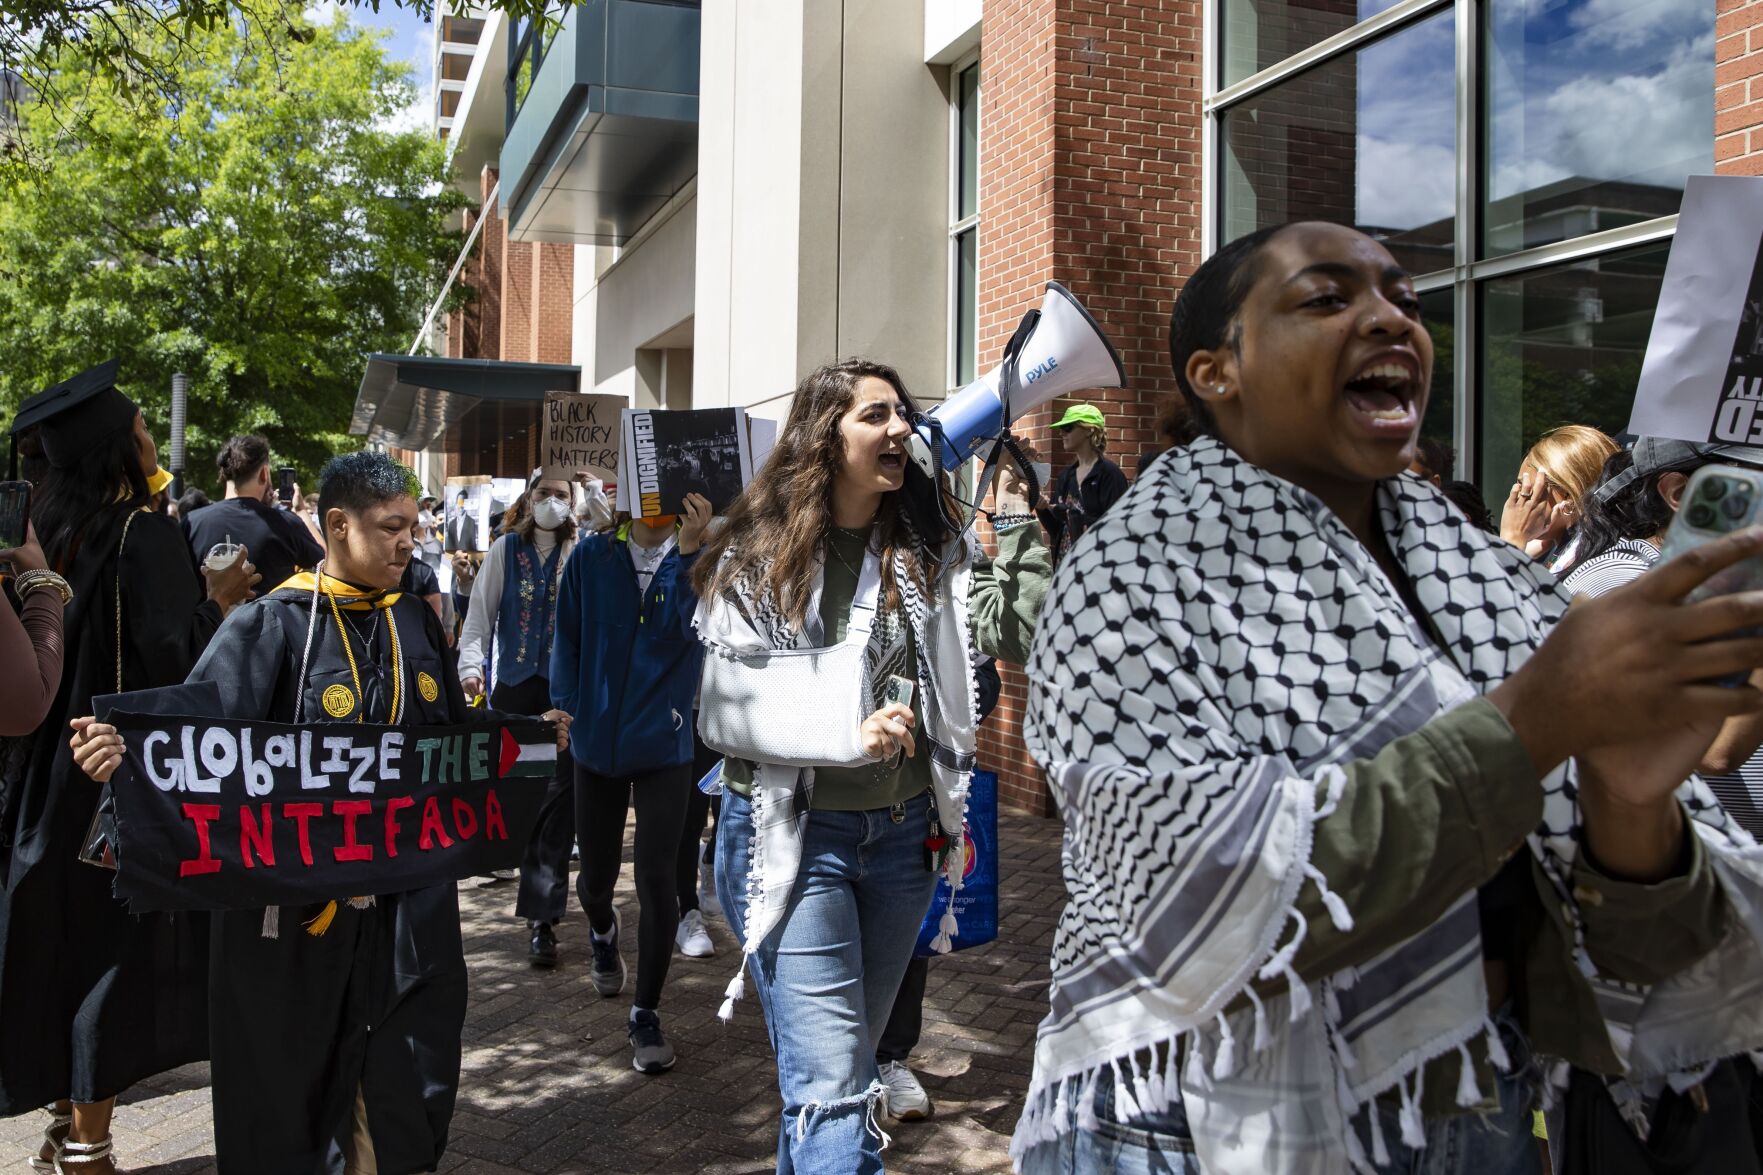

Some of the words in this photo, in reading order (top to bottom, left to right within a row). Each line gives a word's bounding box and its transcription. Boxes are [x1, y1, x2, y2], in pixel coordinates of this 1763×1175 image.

[1025, 357, 1058, 384] PYLE
[548, 400, 597, 424] BLACK
[550, 425, 612, 444] HISTORY
[550, 448, 618, 470] MATTERS
[634, 412, 662, 517] UNDIGNIFIED
[415, 732, 491, 784] THE
[179, 789, 509, 878] INTIFADA
